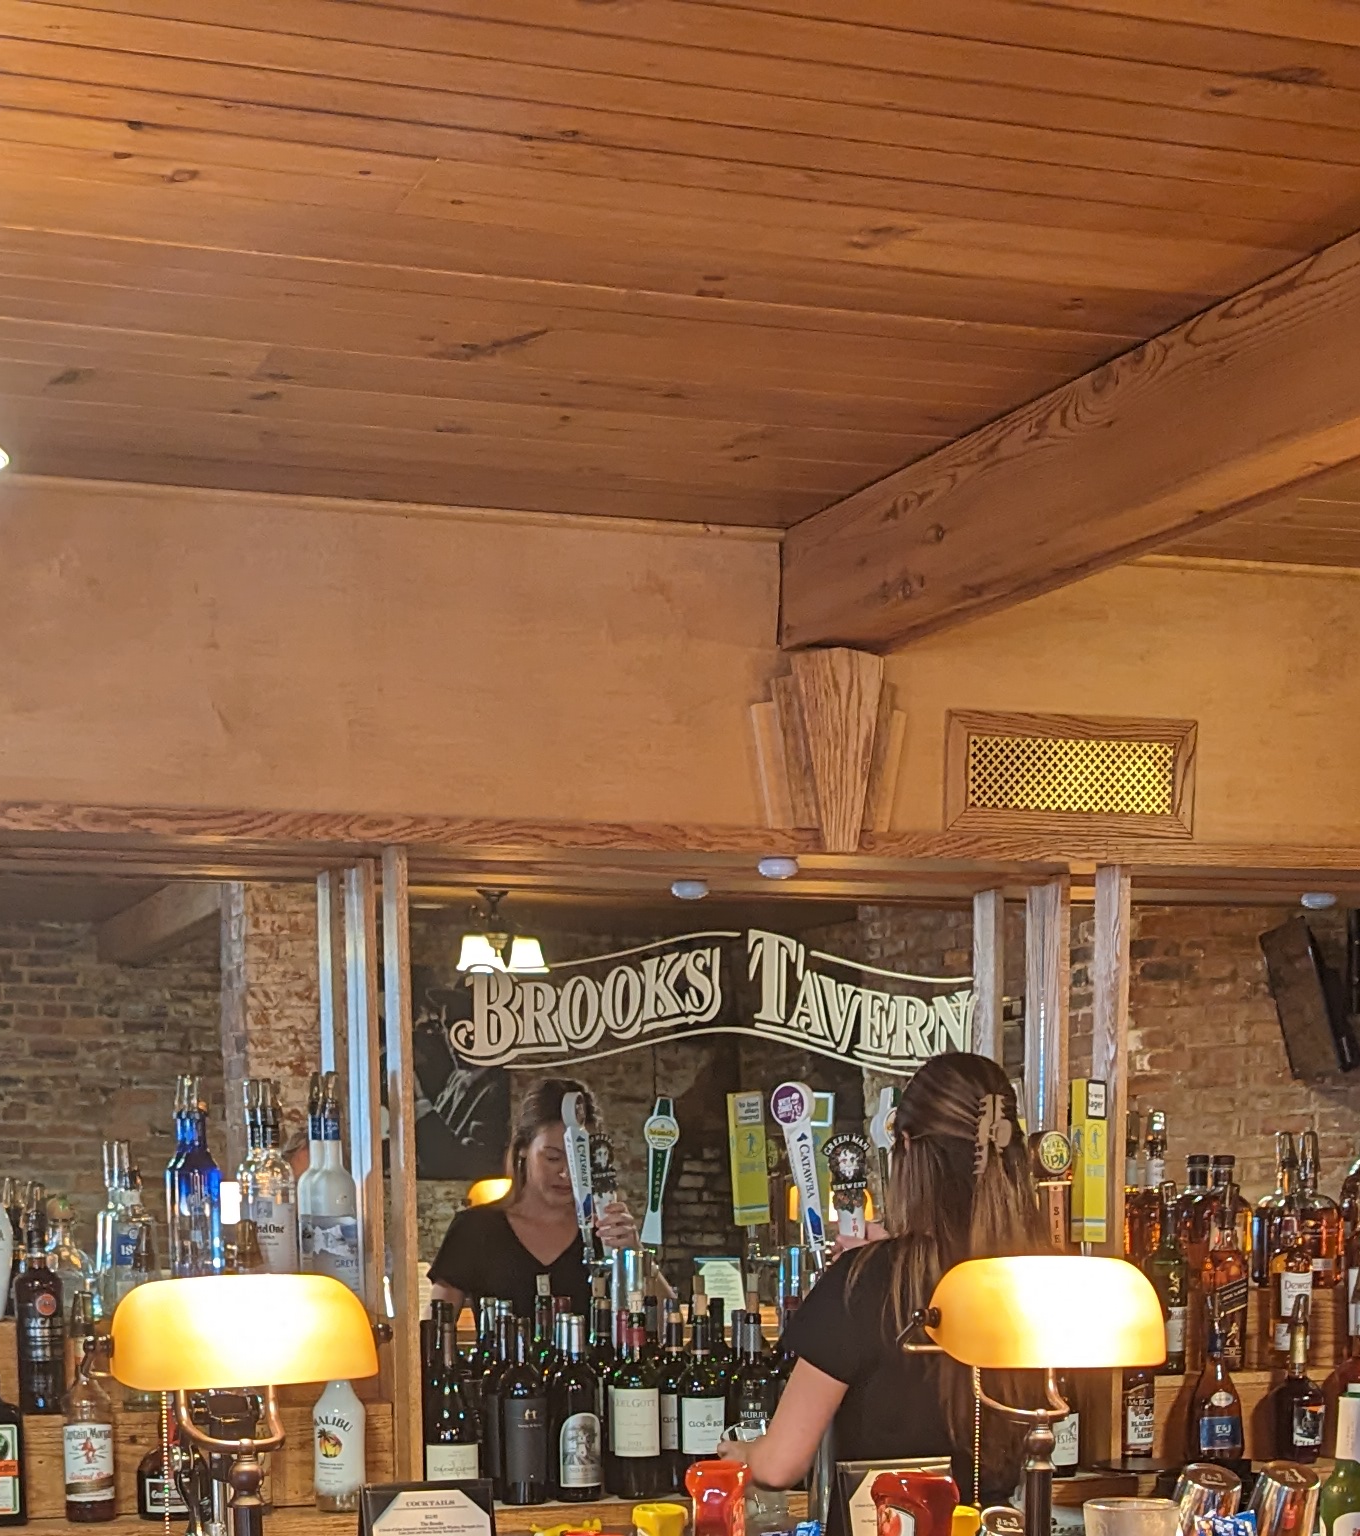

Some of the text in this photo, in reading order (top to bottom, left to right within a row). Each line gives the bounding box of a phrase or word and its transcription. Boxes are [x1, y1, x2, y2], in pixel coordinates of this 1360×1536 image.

[451, 929, 979, 1064] BROOKS TAVERN
[824, 1135, 870, 1156] GREEN MAN
[799, 1144, 815, 1199] CATAWBA
[833, 1181, 867, 1190] BREWERY
[269, 1224, 285, 1234] One
[1053, 1206, 1061, 1244] SIE
[120, 1244, 136, 1256] 18
[1284, 1280, 1312, 1290] Dewar
[314, 1416, 353, 1433] MALIBU
[688, 1420, 706, 1428] CLOS
[89, 1427, 111, 1440] Morga
